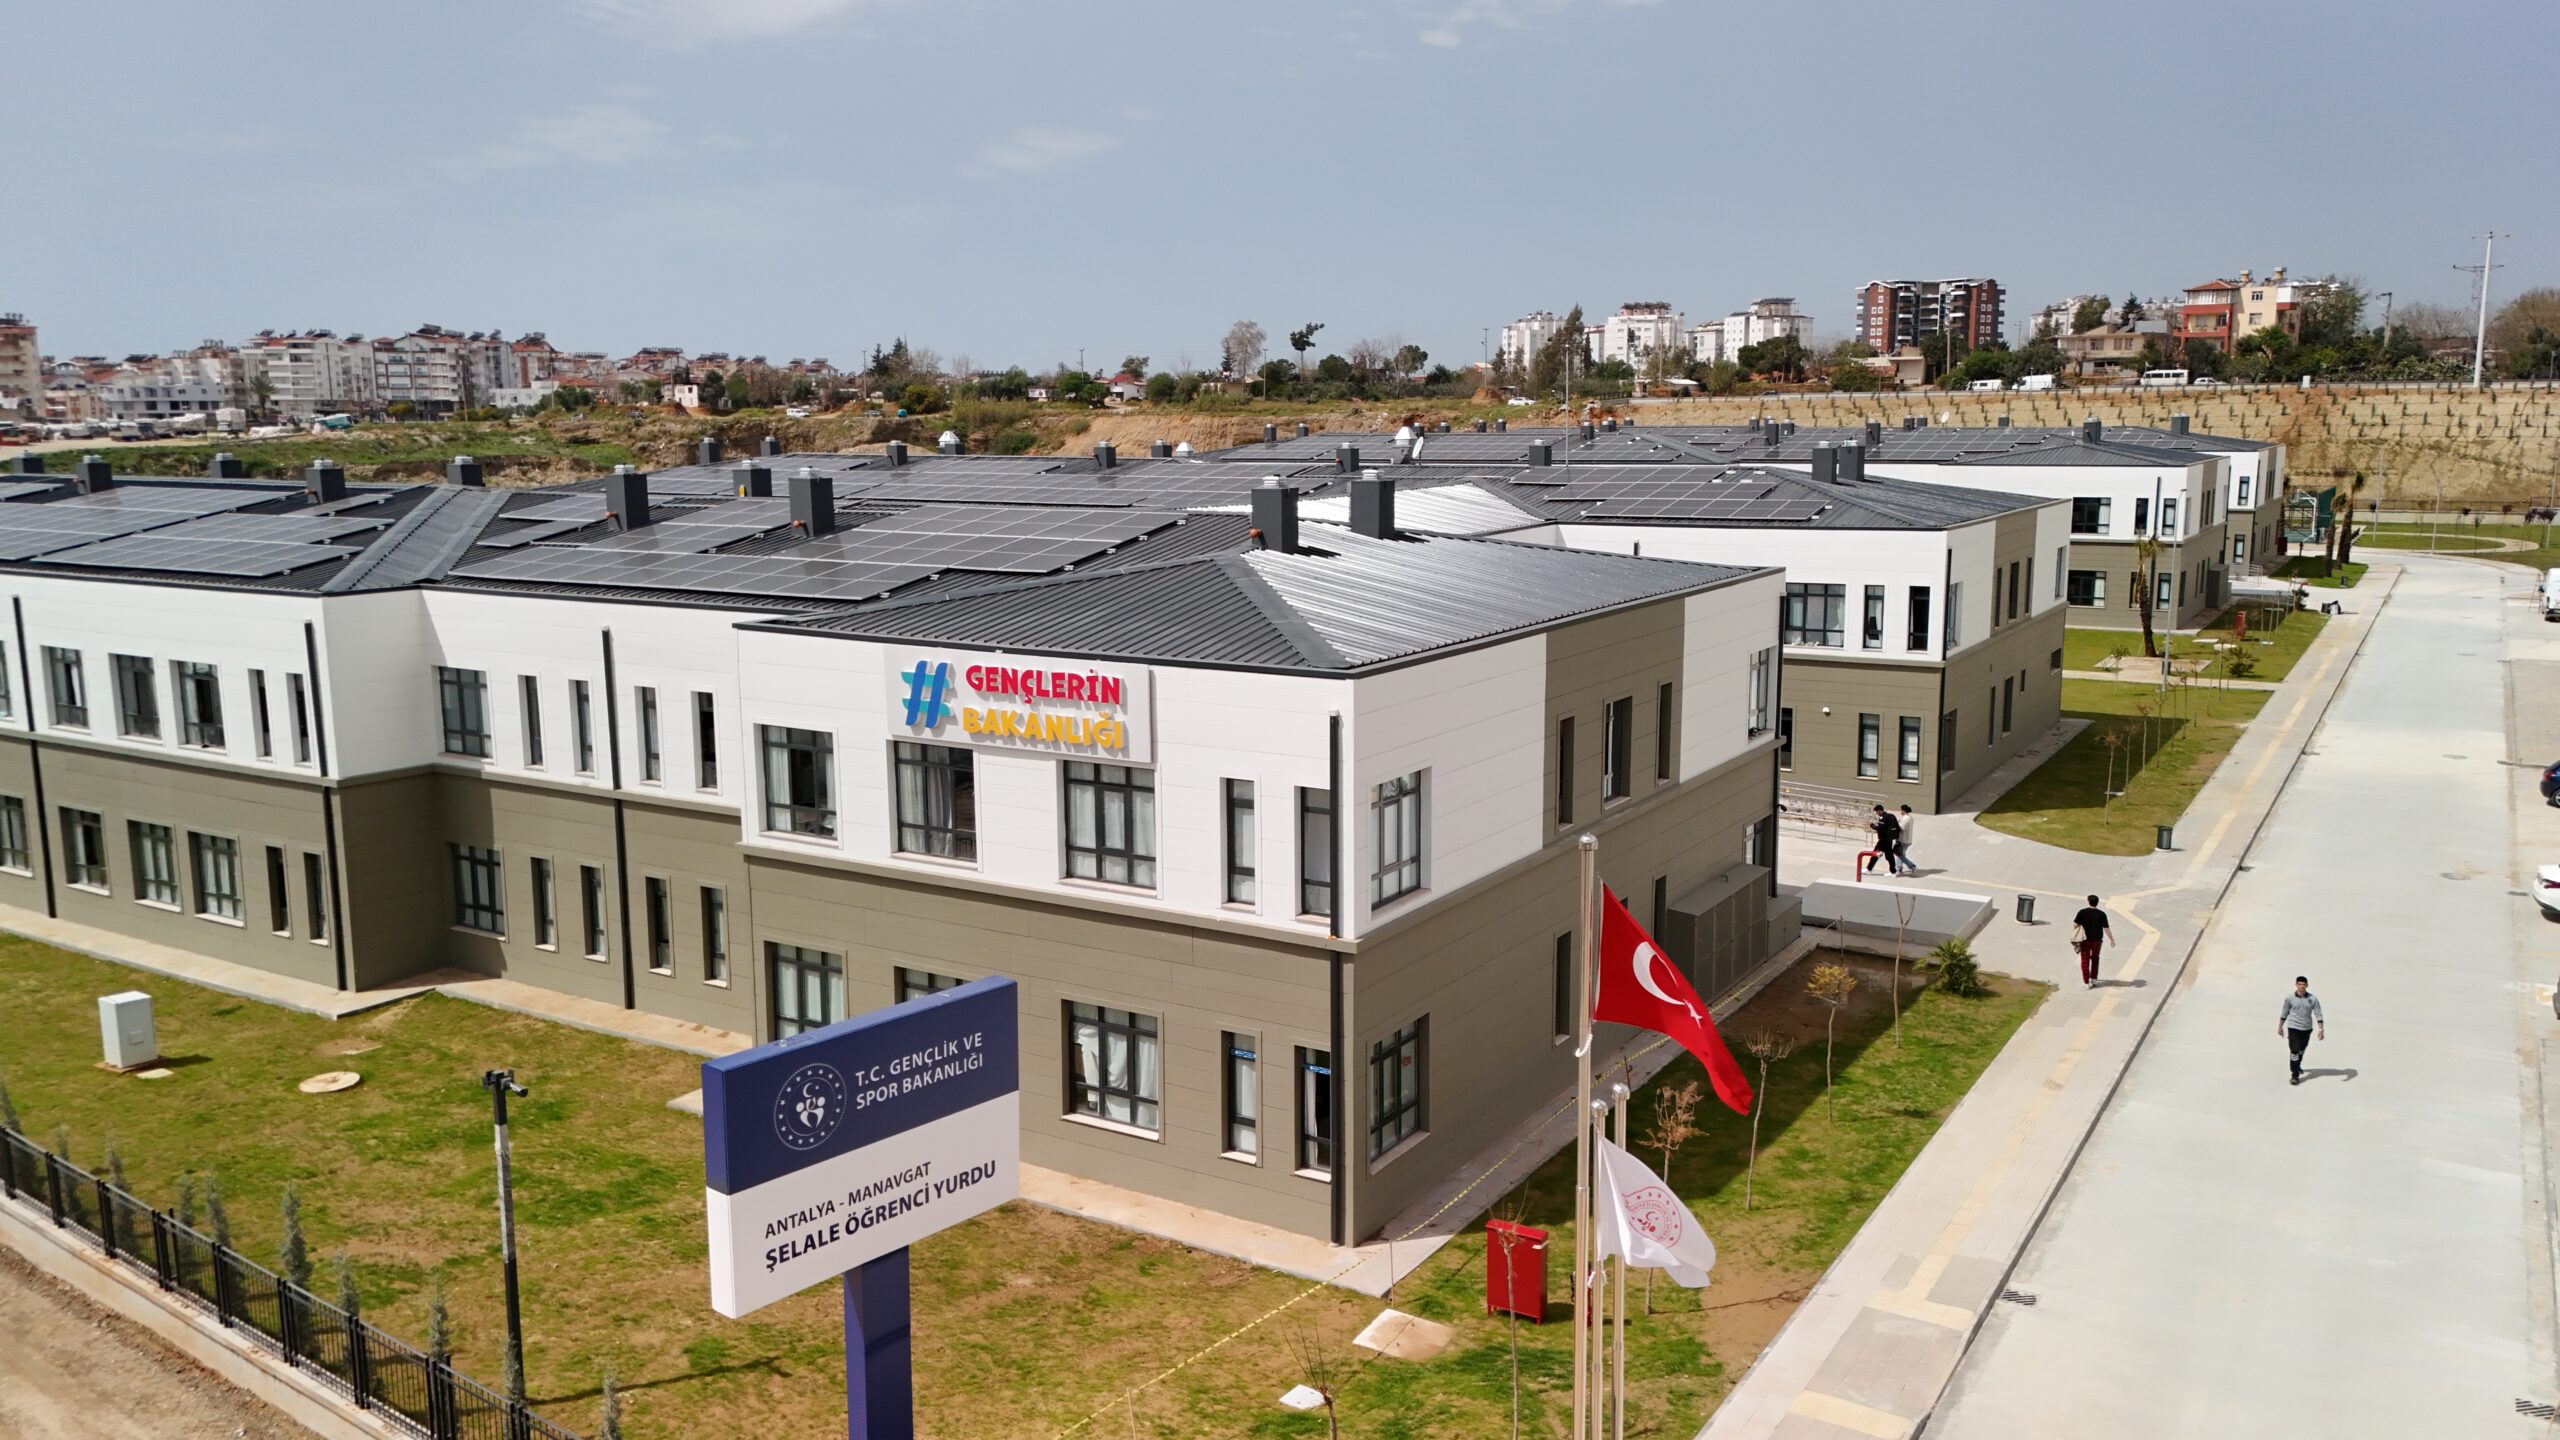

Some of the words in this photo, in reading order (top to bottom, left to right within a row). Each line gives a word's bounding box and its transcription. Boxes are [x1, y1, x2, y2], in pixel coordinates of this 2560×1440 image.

[965, 664, 1120, 705] GENÇLERİN
[963, 707, 1123, 749] BAKANLIĞI
[855, 1066, 885, 1087] T.C.
[889, 1040, 959, 1075] GENÇLİK
[963, 1032, 983, 1051] VE
[855, 1083, 898, 1110] SPOR
[902, 1053, 983, 1094] BAKANLIĞI
[765, 1199, 836, 1239] ANTALYA
[848, 1161, 931, 1207] MANAVGAT
[765, 1223, 841, 1273] ŞELALE
[845, 1182, 930, 1236] ÖĞRENCİ
[934, 1160, 996, 1199] YURDU
